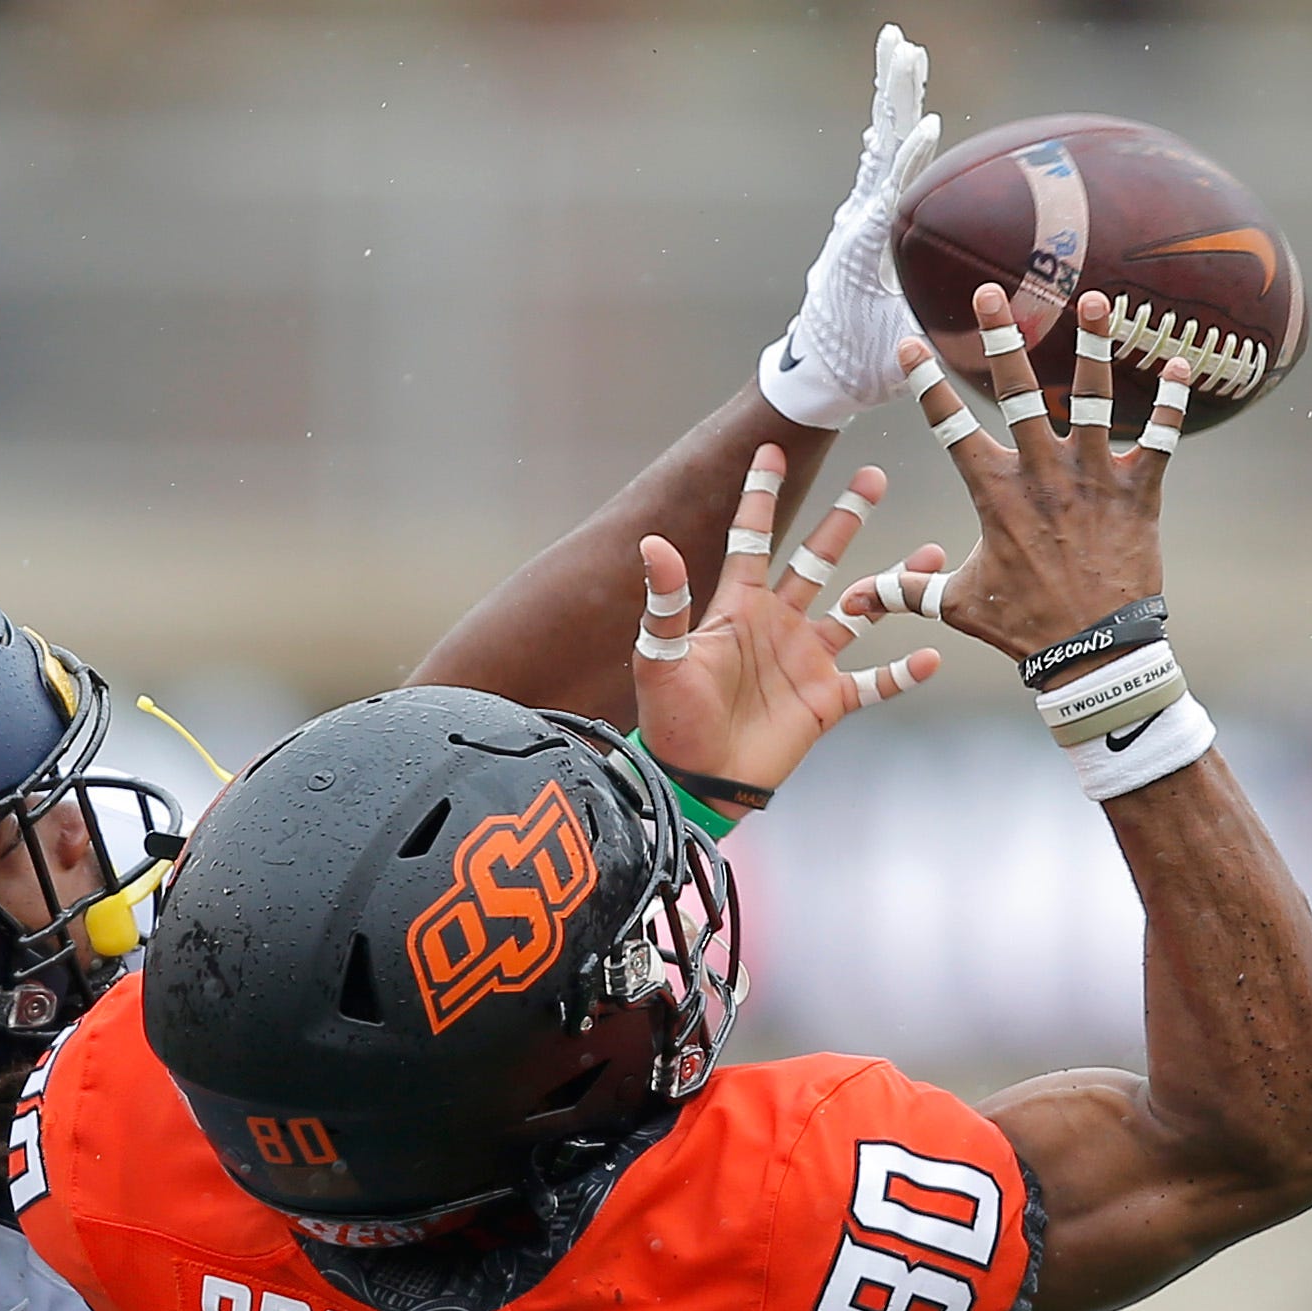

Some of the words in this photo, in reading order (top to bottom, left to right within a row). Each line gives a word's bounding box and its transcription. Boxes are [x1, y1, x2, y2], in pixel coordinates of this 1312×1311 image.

[1043, 629, 1114, 669] SECOND
[1059, 705, 1072, 719] IT
[1073, 686, 1123, 712] WOULD
[1124, 676, 1143, 692] BE
[407, 780, 598, 1036] OSU
[246, 1116, 339, 1167] 80
